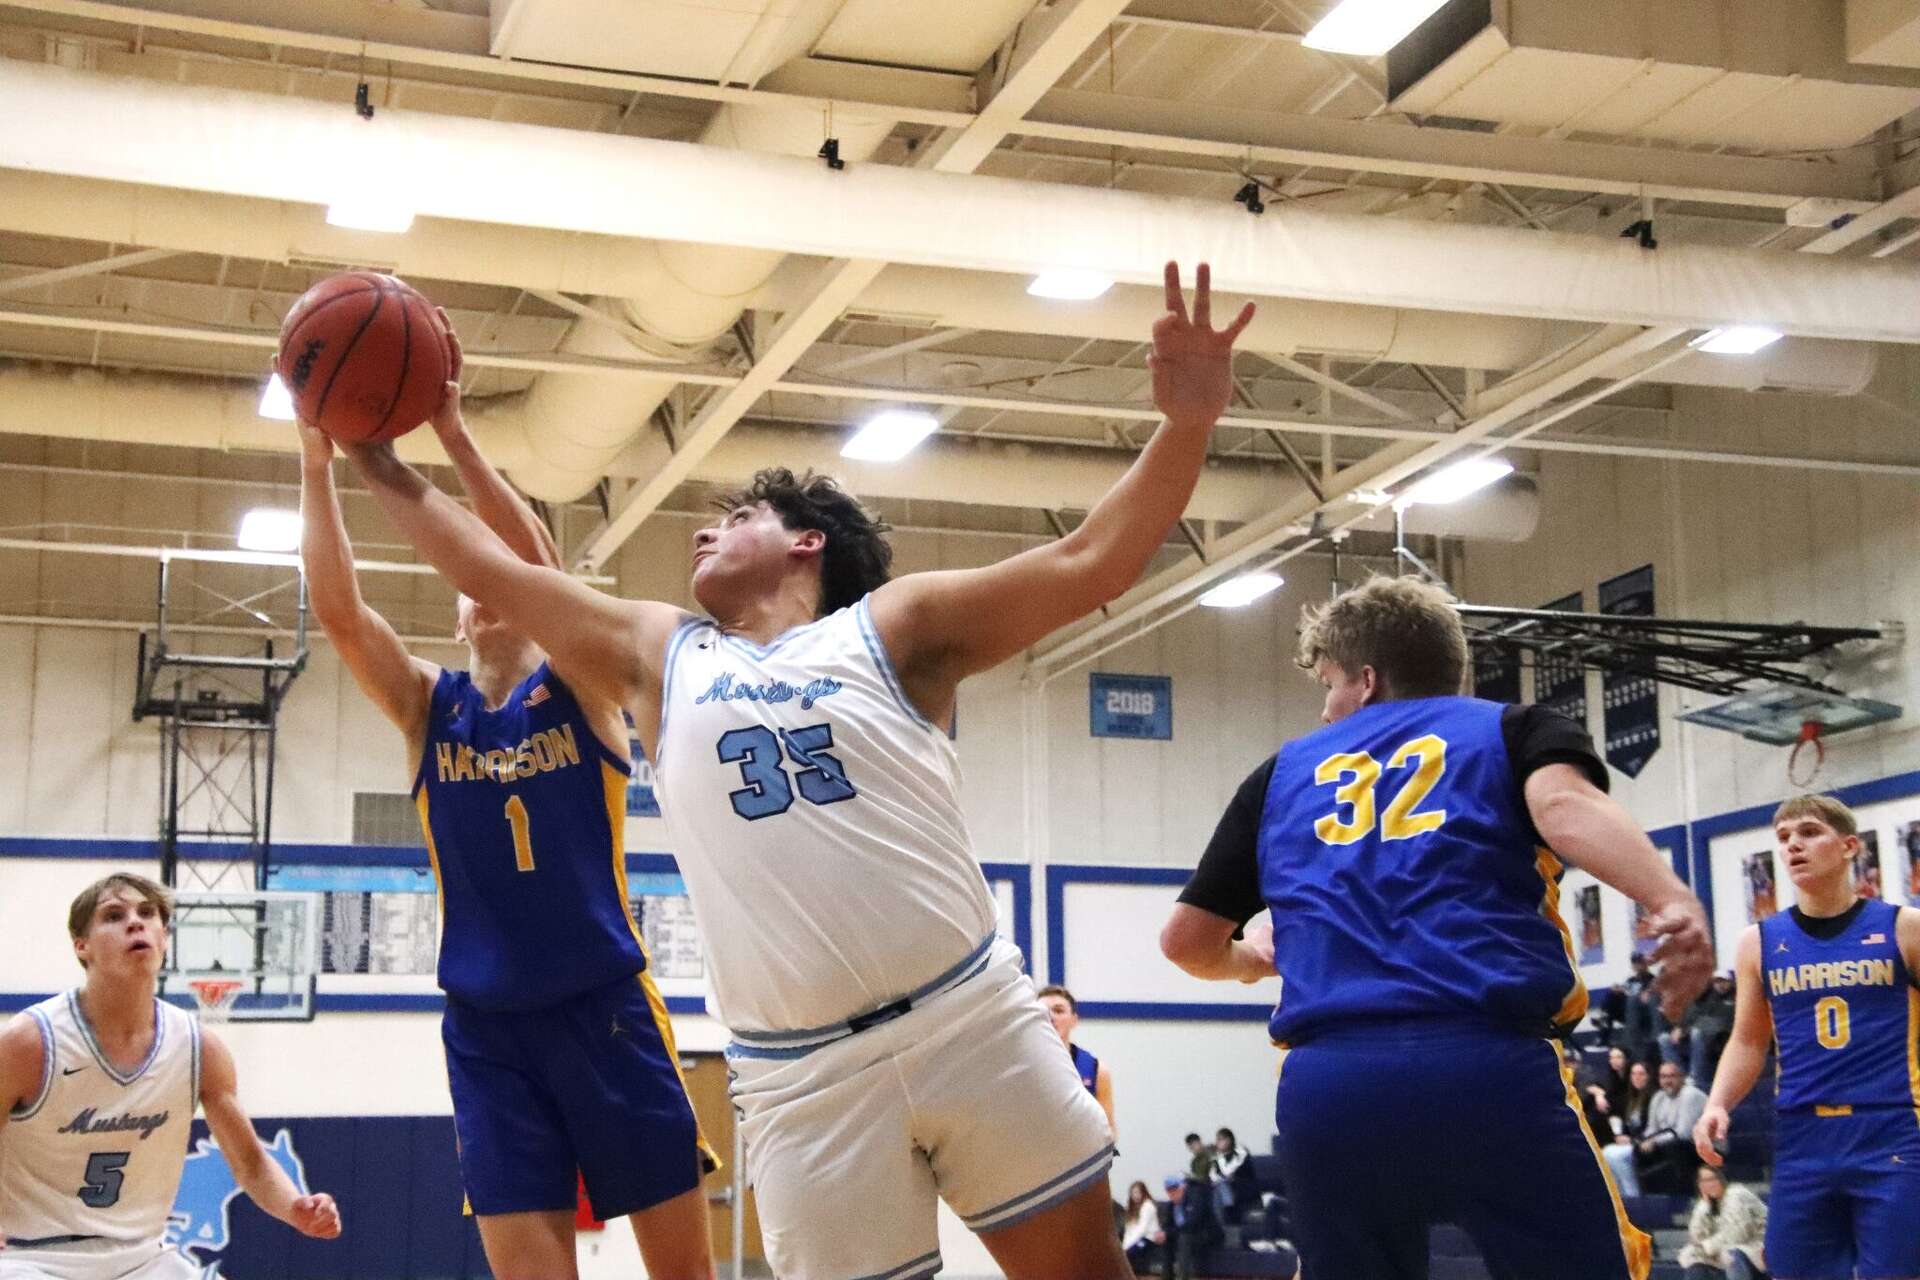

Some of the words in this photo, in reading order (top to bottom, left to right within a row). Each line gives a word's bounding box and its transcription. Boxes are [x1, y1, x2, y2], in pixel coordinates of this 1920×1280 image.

[1107, 691, 1154, 715] 2018
[716, 723, 856, 821] 35
[1314, 734, 1447, 845] 32
[504, 795, 535, 871] 1
[1768, 959, 1893, 996] HARRISON
[1815, 996, 1850, 1049] 0
[57, 1108, 168, 1140] Mustangs
[77, 1152, 131, 1208] 5
